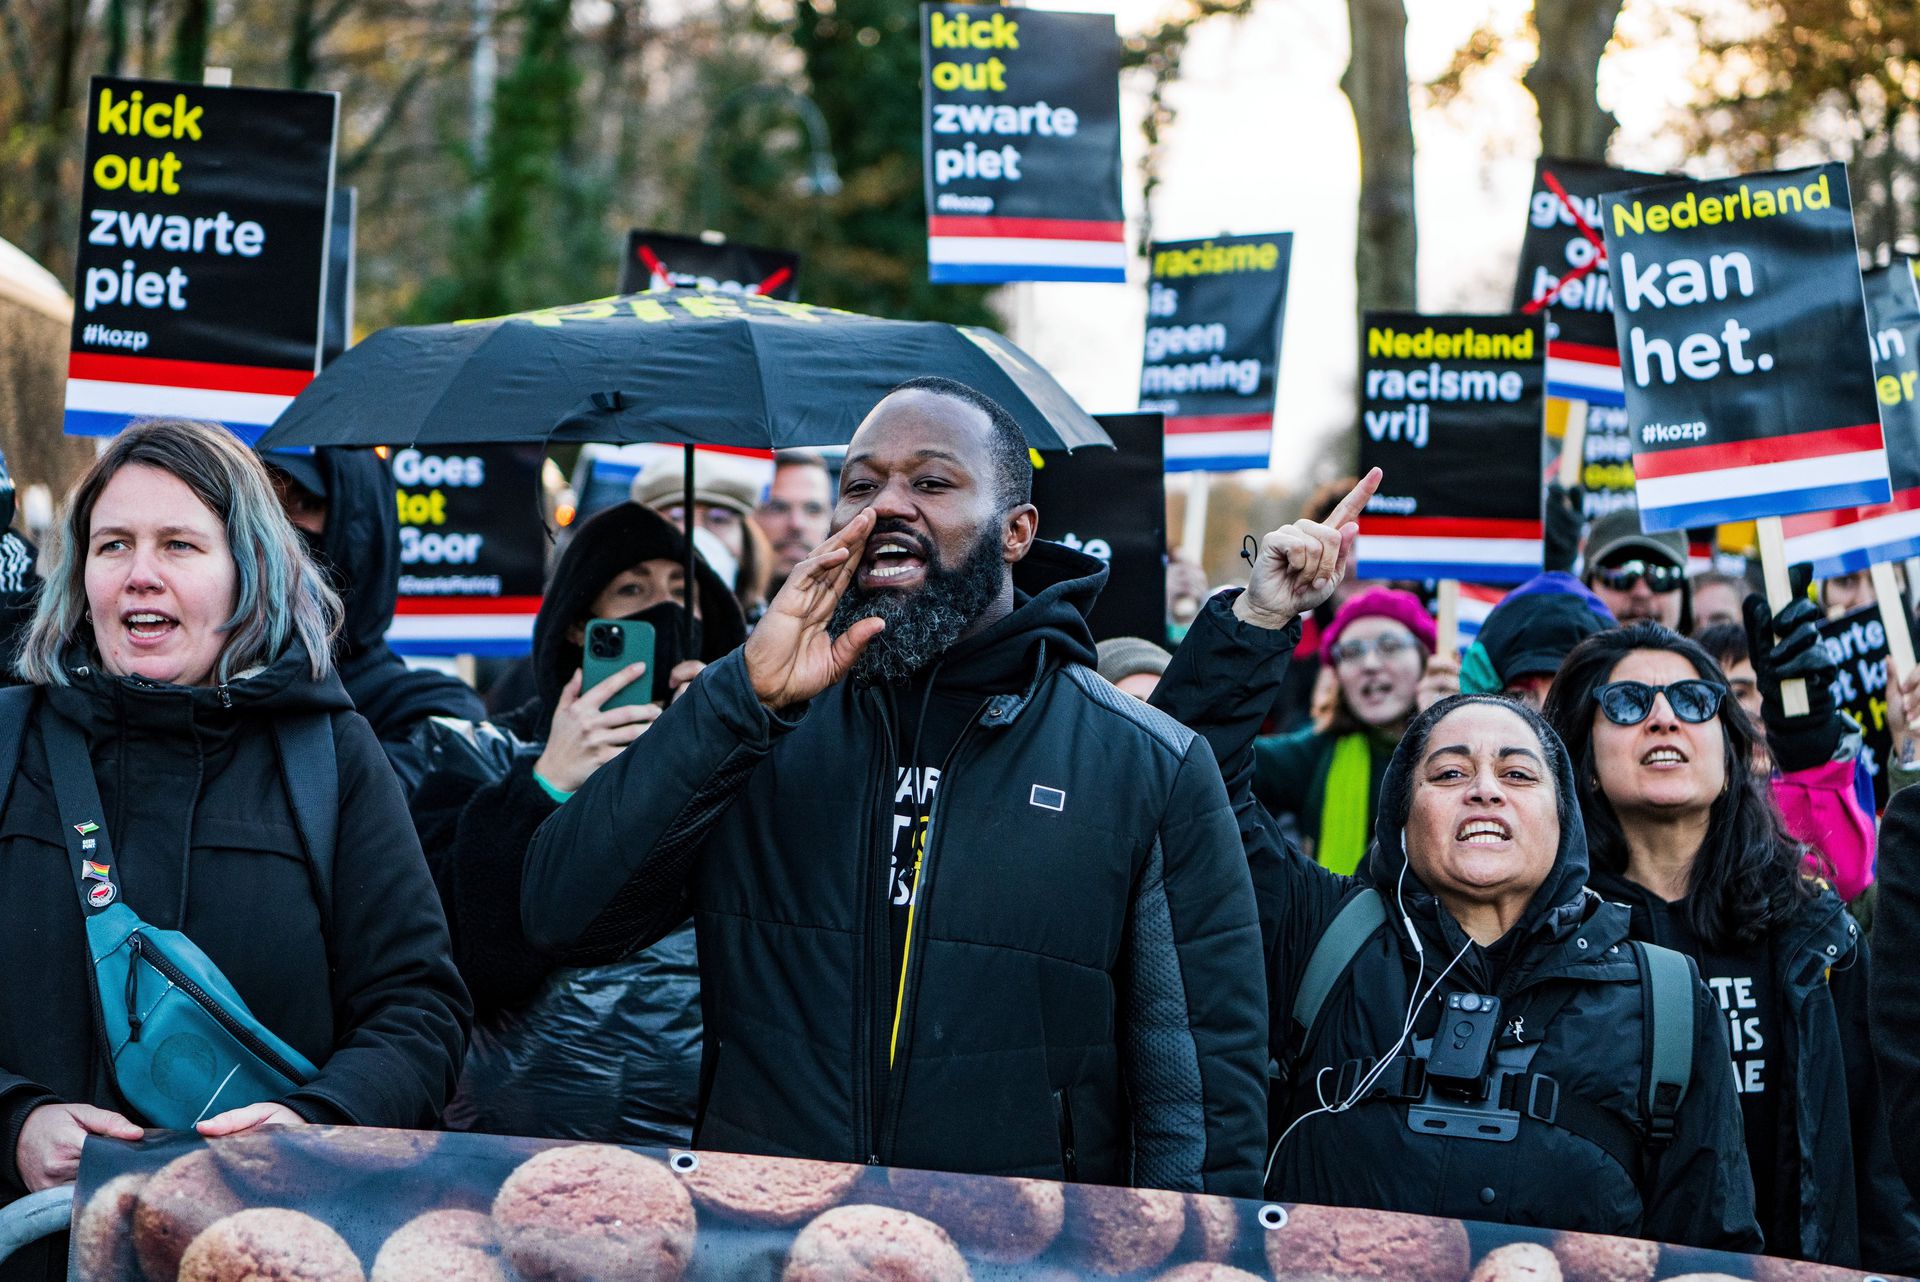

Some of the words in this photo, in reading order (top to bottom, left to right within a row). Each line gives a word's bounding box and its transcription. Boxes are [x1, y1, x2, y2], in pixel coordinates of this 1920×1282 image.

[930, 12, 1019, 49] kick
[931, 57, 1007, 91] out
[98, 88, 204, 141] kick
[933, 101, 1078, 136] zwarte
[93, 151, 182, 195] out
[935, 141, 1021, 185] piet
[1612, 174, 1831, 238] Nederland
[88, 209, 266, 257] zwarte
[1153, 241, 1279, 278] racisme
[84, 259, 188, 312] piet
[1150, 282, 1178, 317] is
[1620, 250, 1754, 312] kan
[82, 324, 149, 351] #kozp
[1146, 323, 1226, 361] geen
[1368, 327, 1534, 359] Nederland
[1630, 318, 1774, 388] het.
[1141, 354, 1261, 395] mening
[1366, 362, 1523, 401] racisme
[1364, 403, 1429, 448] vrij
[1642, 418, 1707, 444] #kozp
[393, 448, 484, 487] Goes
[396, 489, 446, 525] tot
